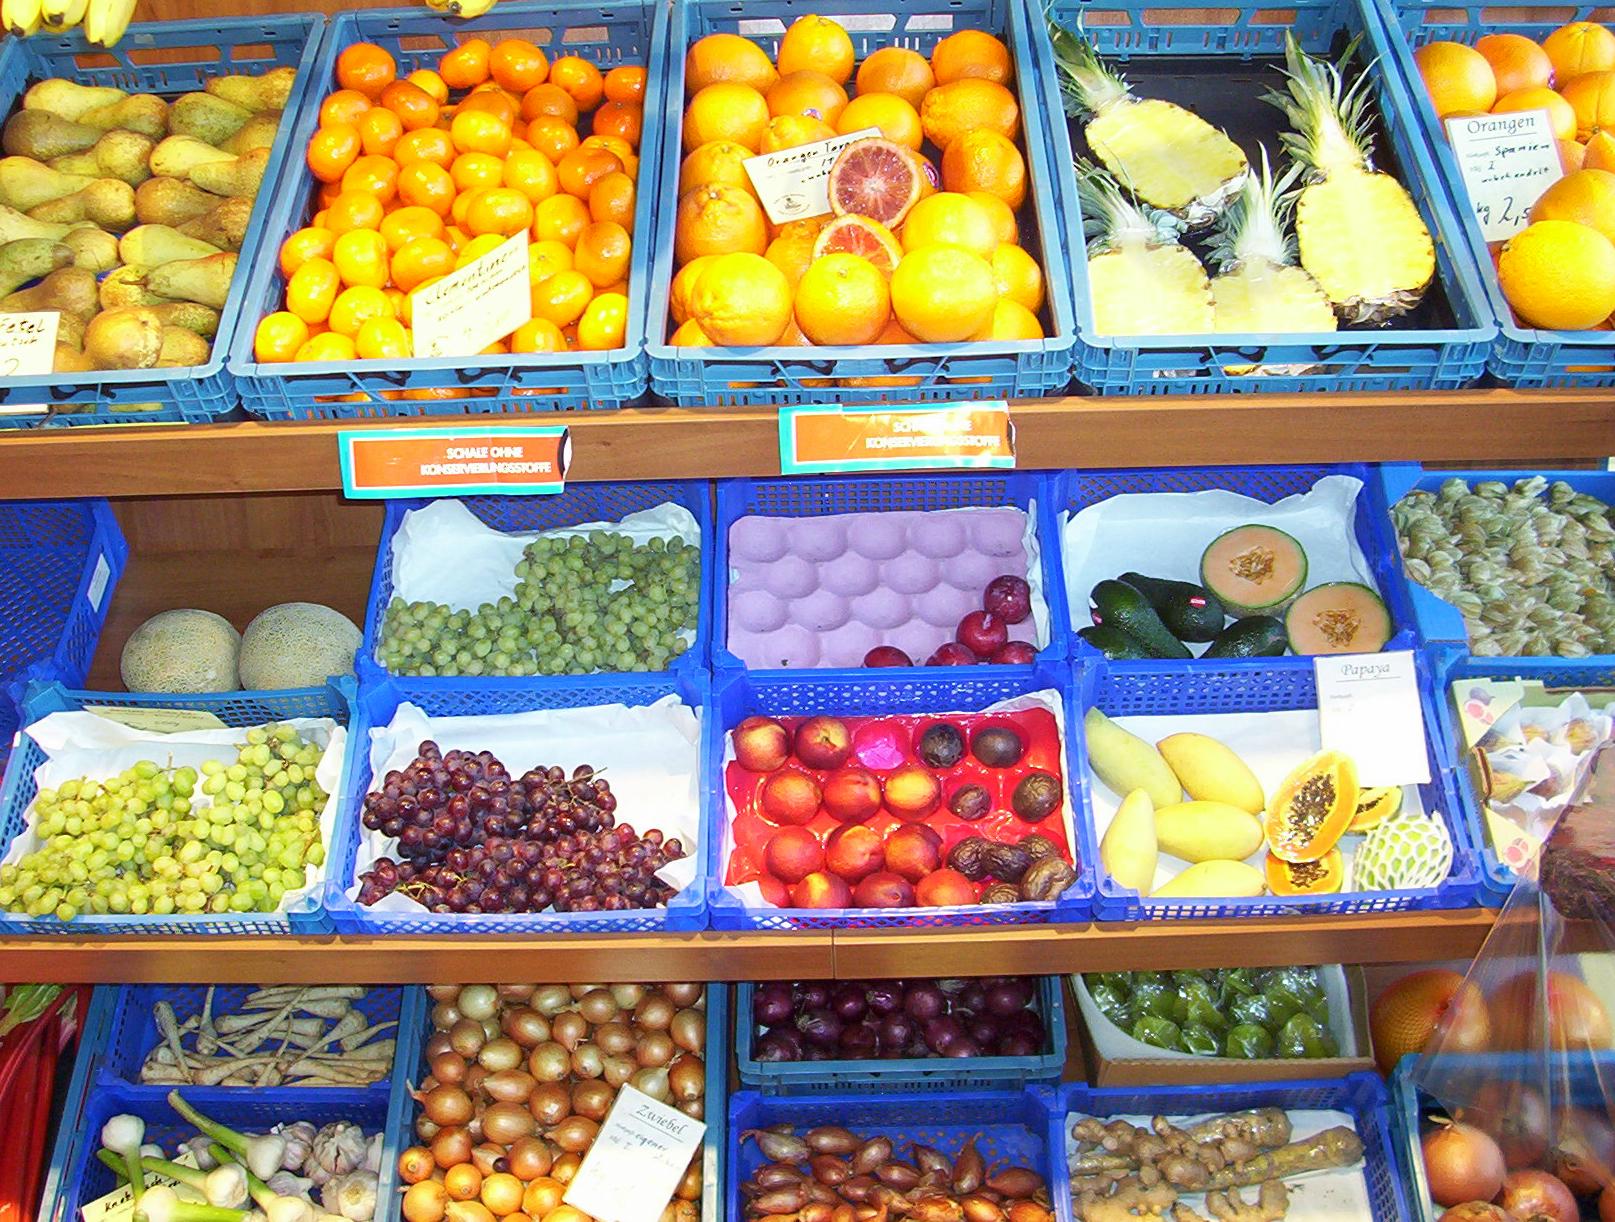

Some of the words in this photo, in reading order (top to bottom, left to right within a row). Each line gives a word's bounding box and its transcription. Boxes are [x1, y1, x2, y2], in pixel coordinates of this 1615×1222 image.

[1467, 116, 1536, 134] Orangen
[767, 151, 818, 167] Orangen
[1498, 196, 1532, 226] 2,5
[446, 447, 488, 460] SCHALE
[490, 446, 523, 459] OHNE
[1341, 663, 1390, 680] Papaya
